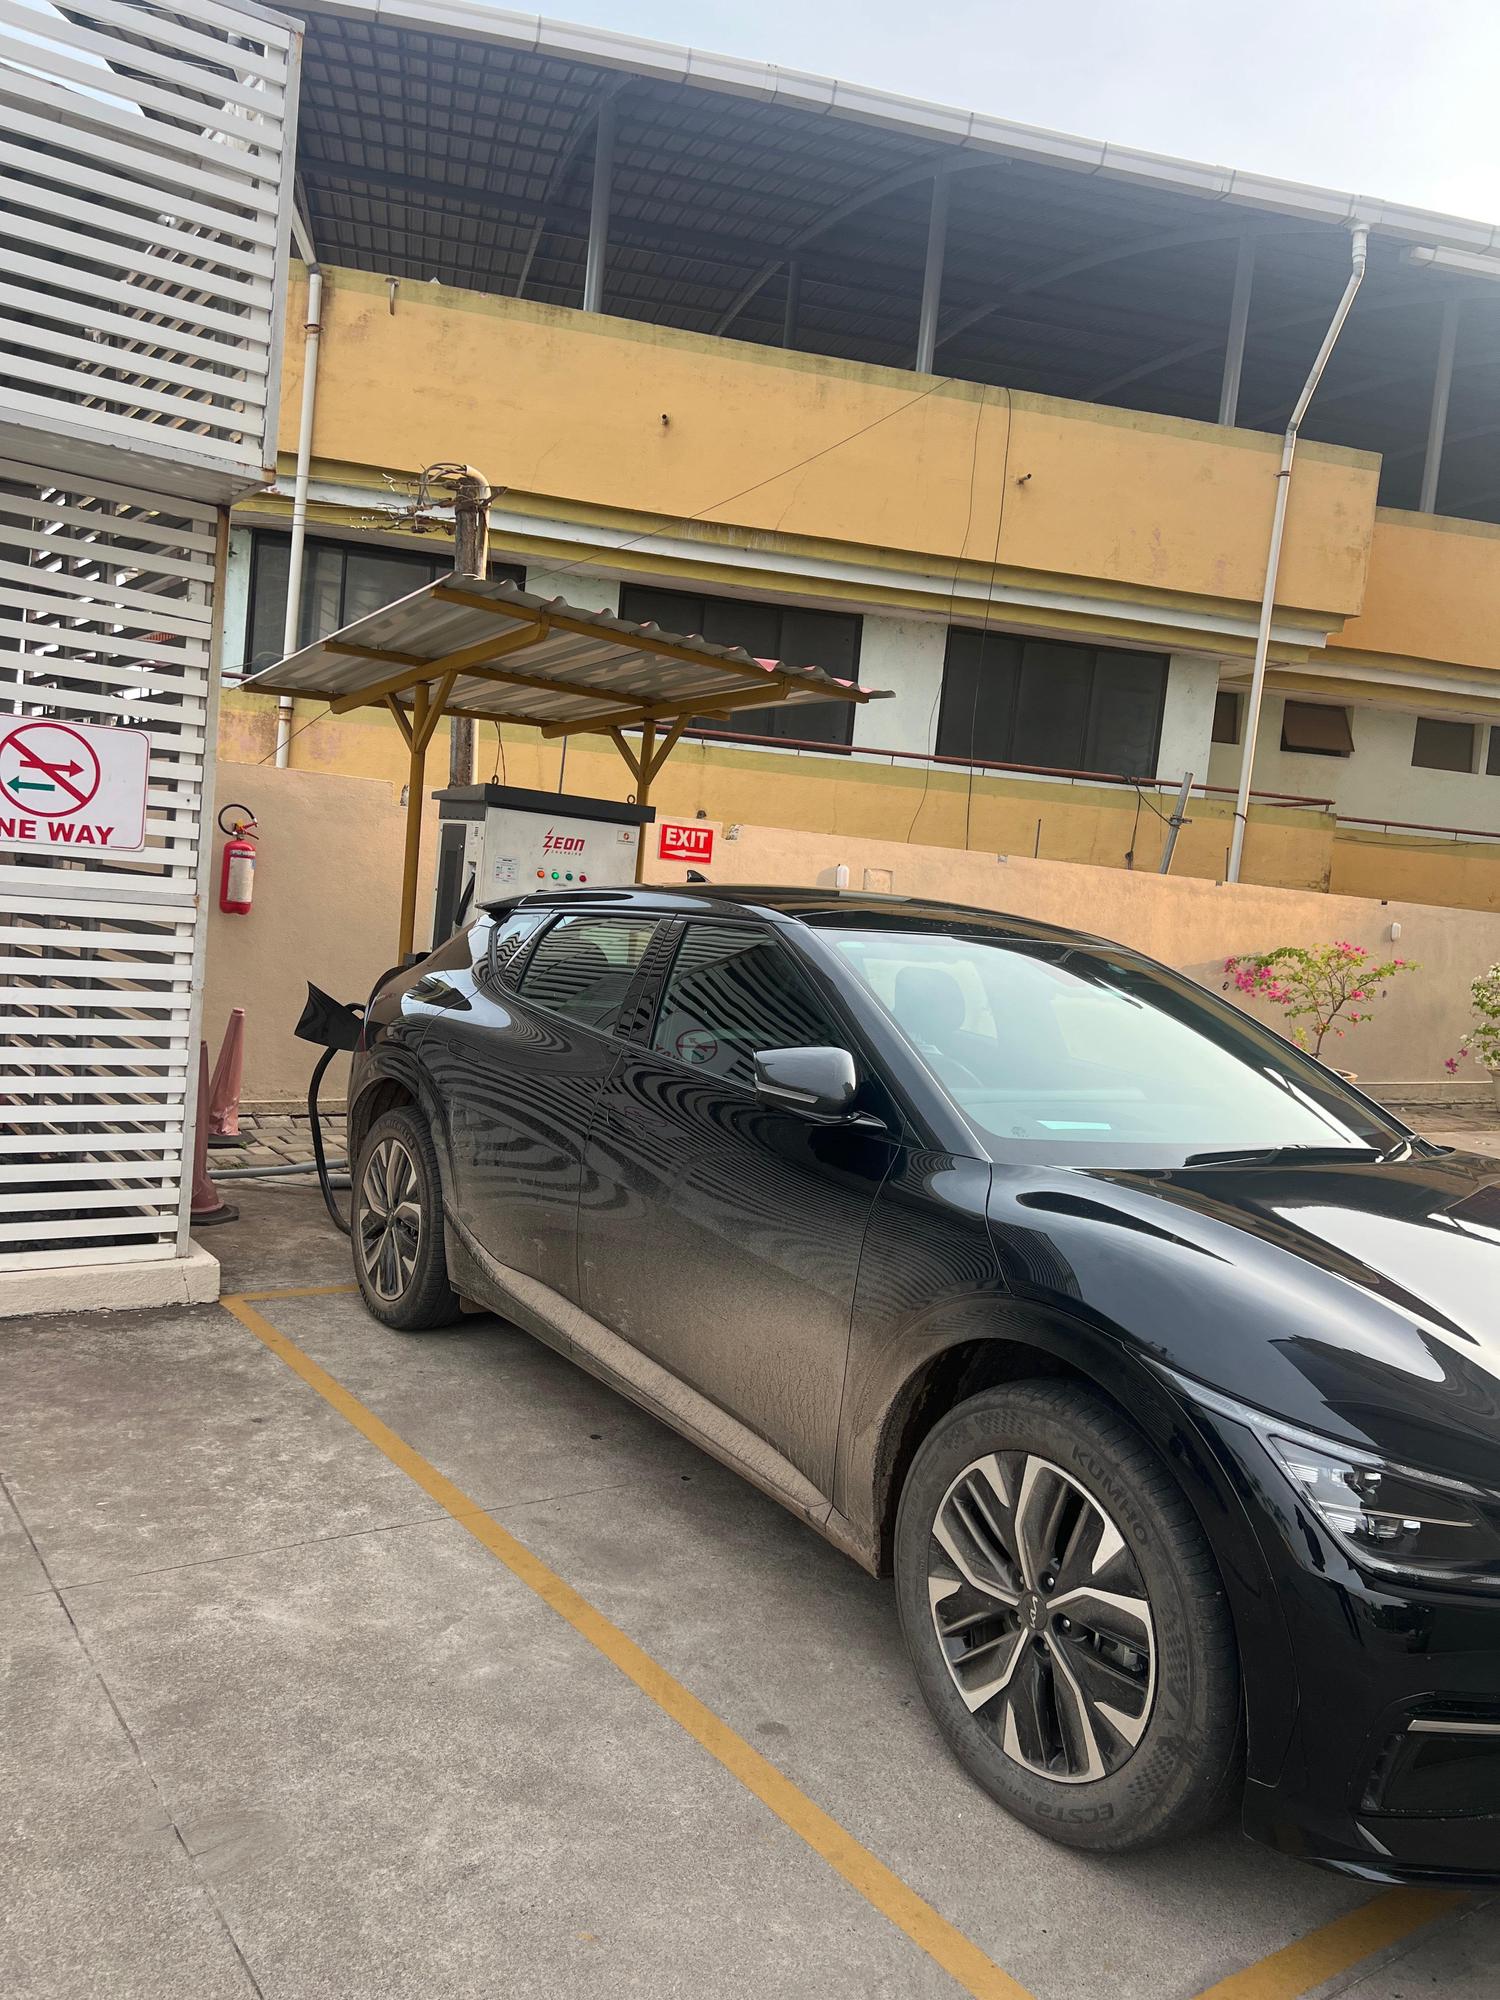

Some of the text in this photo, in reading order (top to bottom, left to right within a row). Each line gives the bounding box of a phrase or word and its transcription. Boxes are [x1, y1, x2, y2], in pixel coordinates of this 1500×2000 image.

[0, 817, 114, 845] NE WAY
[542, 828, 586, 856] ZEON
[665, 827, 709, 850] EXIT
[1072, 1444, 1148, 1545] KUMHO
